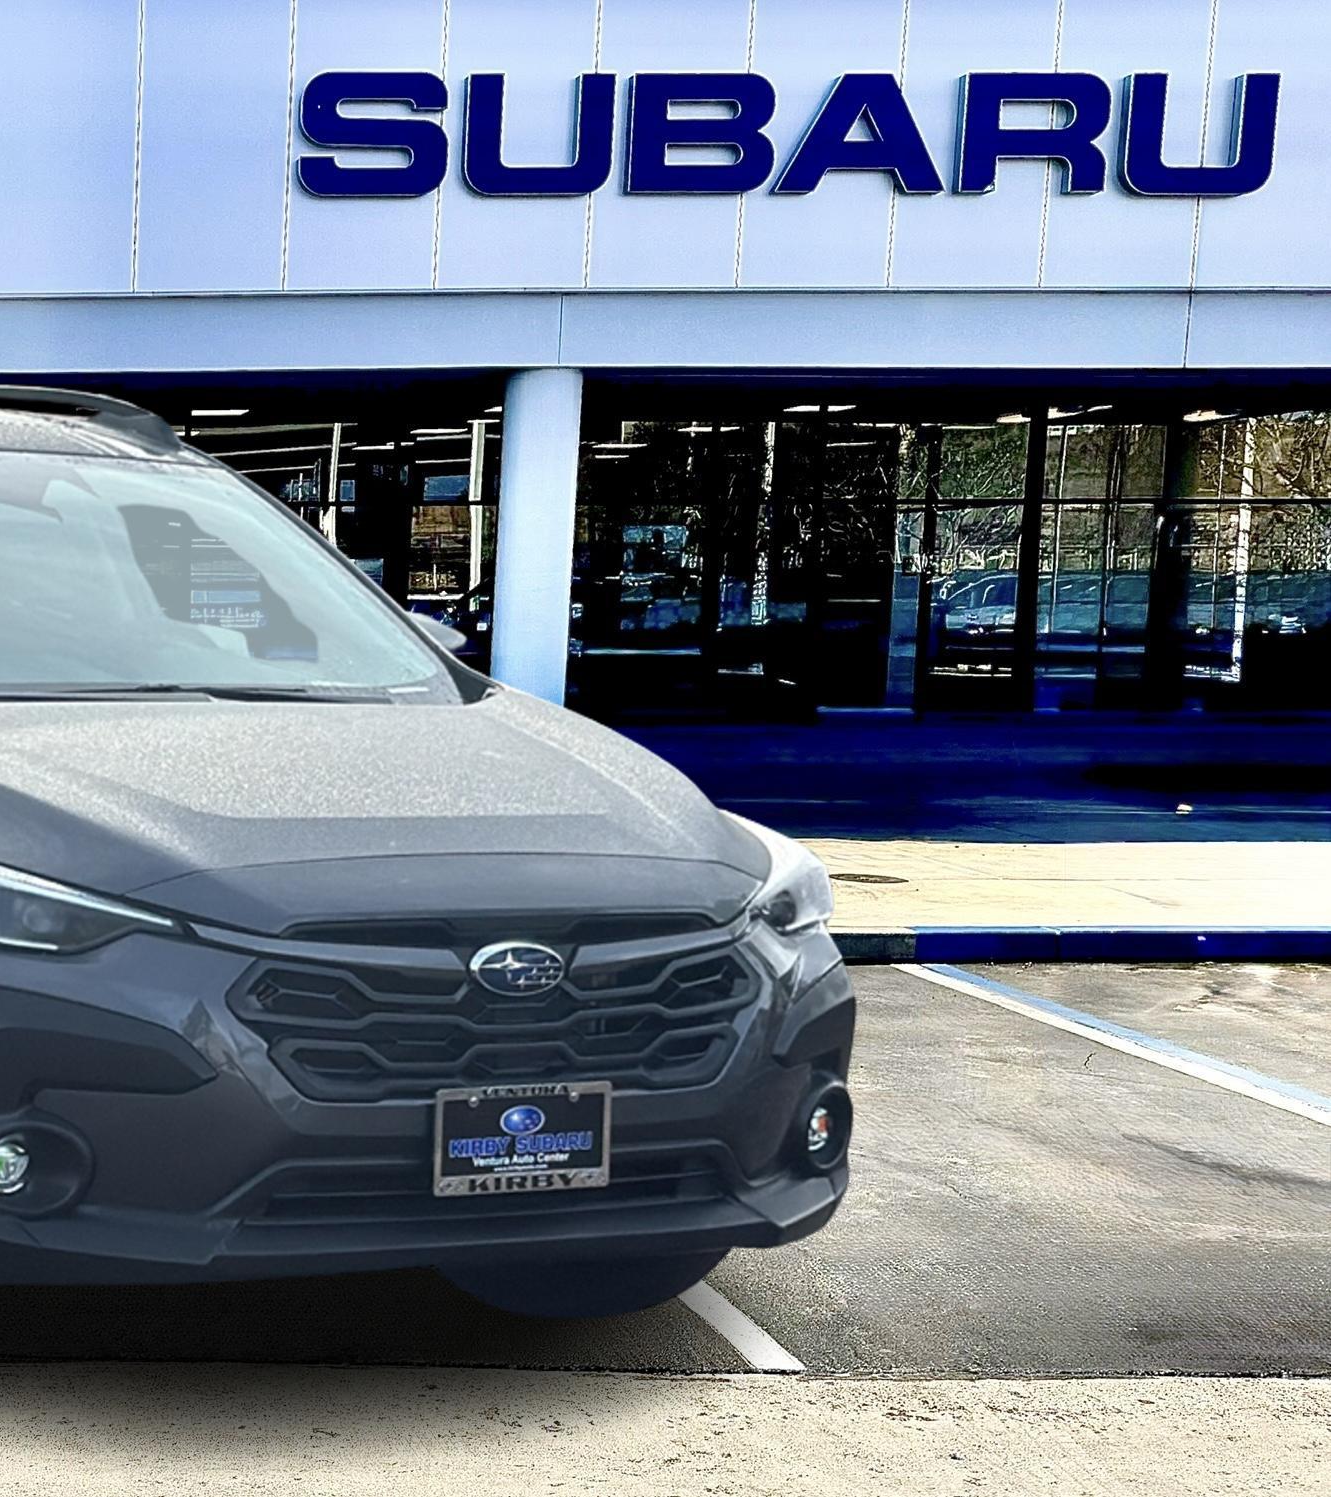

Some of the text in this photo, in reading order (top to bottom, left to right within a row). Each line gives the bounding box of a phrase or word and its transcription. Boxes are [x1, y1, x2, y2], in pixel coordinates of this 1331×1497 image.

[297, 71, 1281, 198] SUBARU
[482, 1085, 569, 1098] VENTURA
[449, 1131, 593, 1158] KIRBY SUBARU
[472, 1152, 570, 1167] Ventura Auto Center
[469, 1173, 576, 1192] KIRBY
